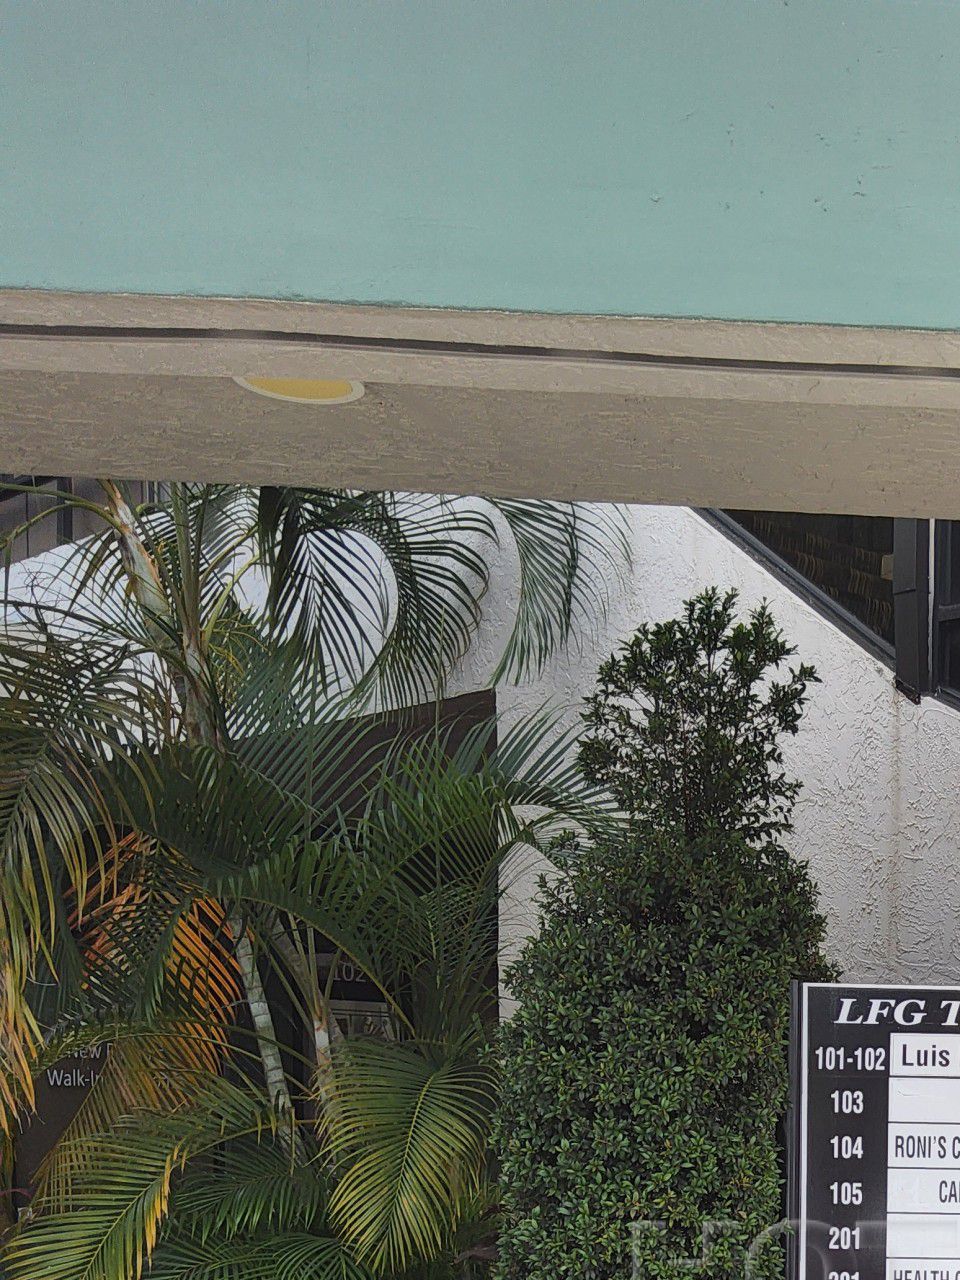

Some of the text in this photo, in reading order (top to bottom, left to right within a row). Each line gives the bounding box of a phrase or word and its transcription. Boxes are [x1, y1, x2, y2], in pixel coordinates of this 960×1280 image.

[834, 998, 927, 1026] LFG
[815, 1046, 886, 1071] 101-102
[901, 1043, 951, 1068] Luis
[830, 1090, 864, 1114] 103
[830, 1135, 864, 1159] 104
[895, 1135, 947, 1159] RONI'S
[829, 1181, 863, 1206] 105
[828, 1226, 861, 1250] 201
